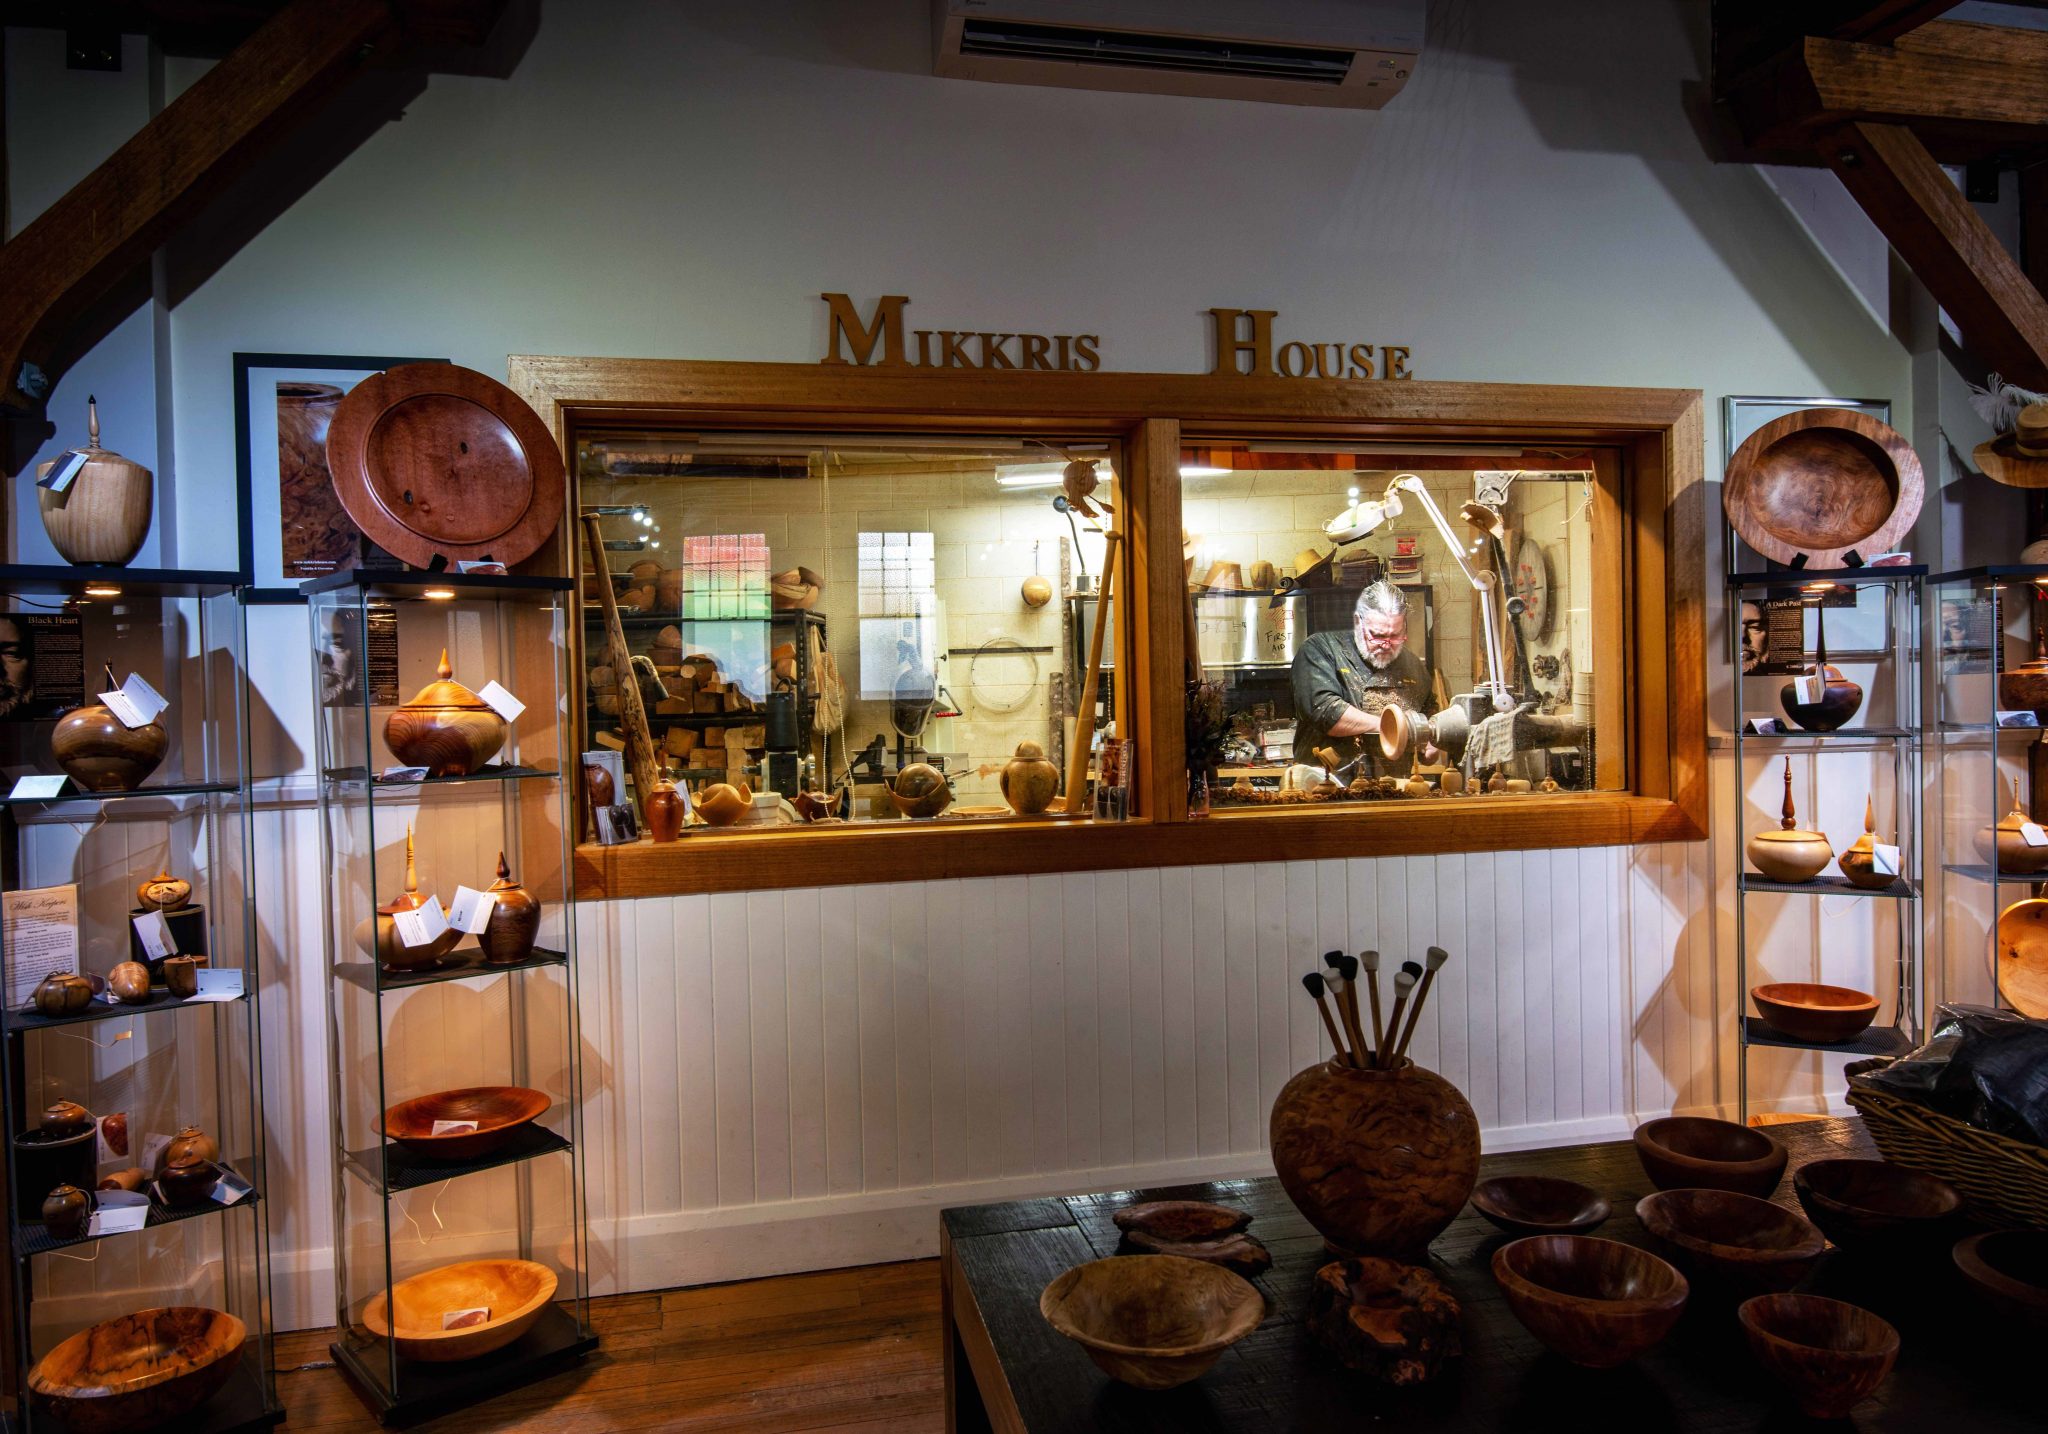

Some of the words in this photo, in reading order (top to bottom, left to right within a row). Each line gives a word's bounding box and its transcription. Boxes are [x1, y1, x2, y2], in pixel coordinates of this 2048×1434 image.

[820, 292, 1101, 371] MIKKRIS
[1208, 307, 1414, 381] HOUSE
[28, 616, 53, 624] Black
[55, 616, 79, 625] Heart
[1265, 630, 1293, 643] FIRST
[1272, 643, 1286, 652] AID
[12, 899, 32, 911] Wish
